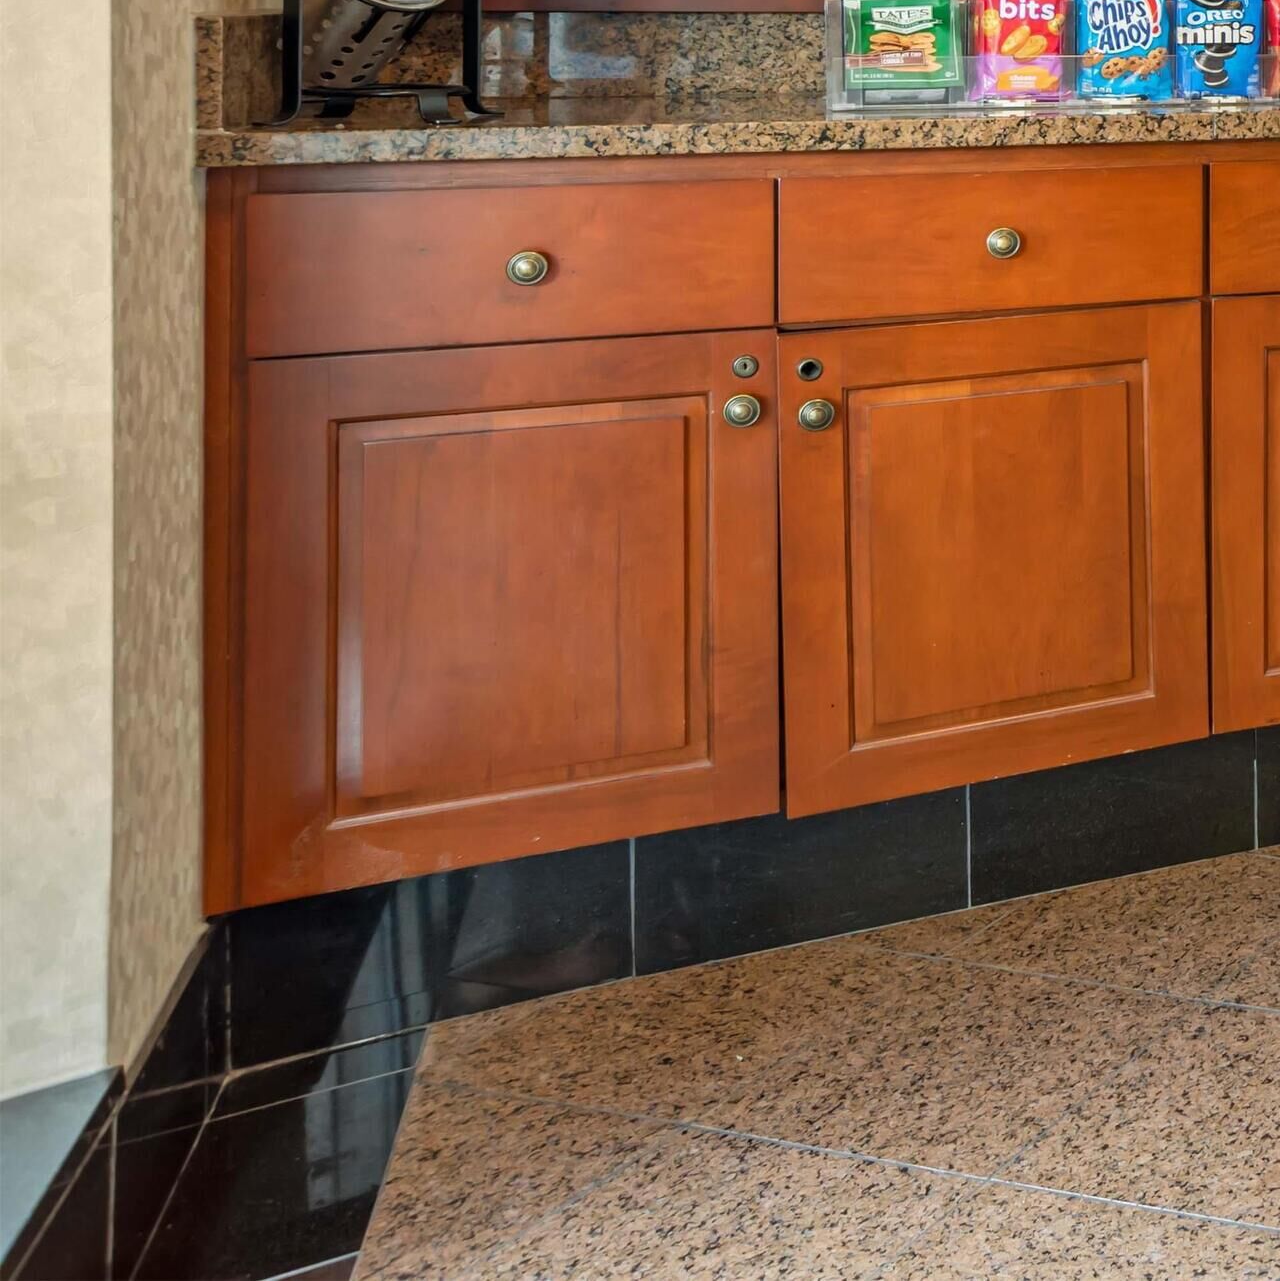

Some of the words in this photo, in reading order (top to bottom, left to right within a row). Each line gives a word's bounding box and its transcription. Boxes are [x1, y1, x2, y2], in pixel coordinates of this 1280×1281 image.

[875, 8, 931, 19] TATE'S
[1187, 9, 1244, 25] OREO
[1177, 22, 1255, 44] minis
